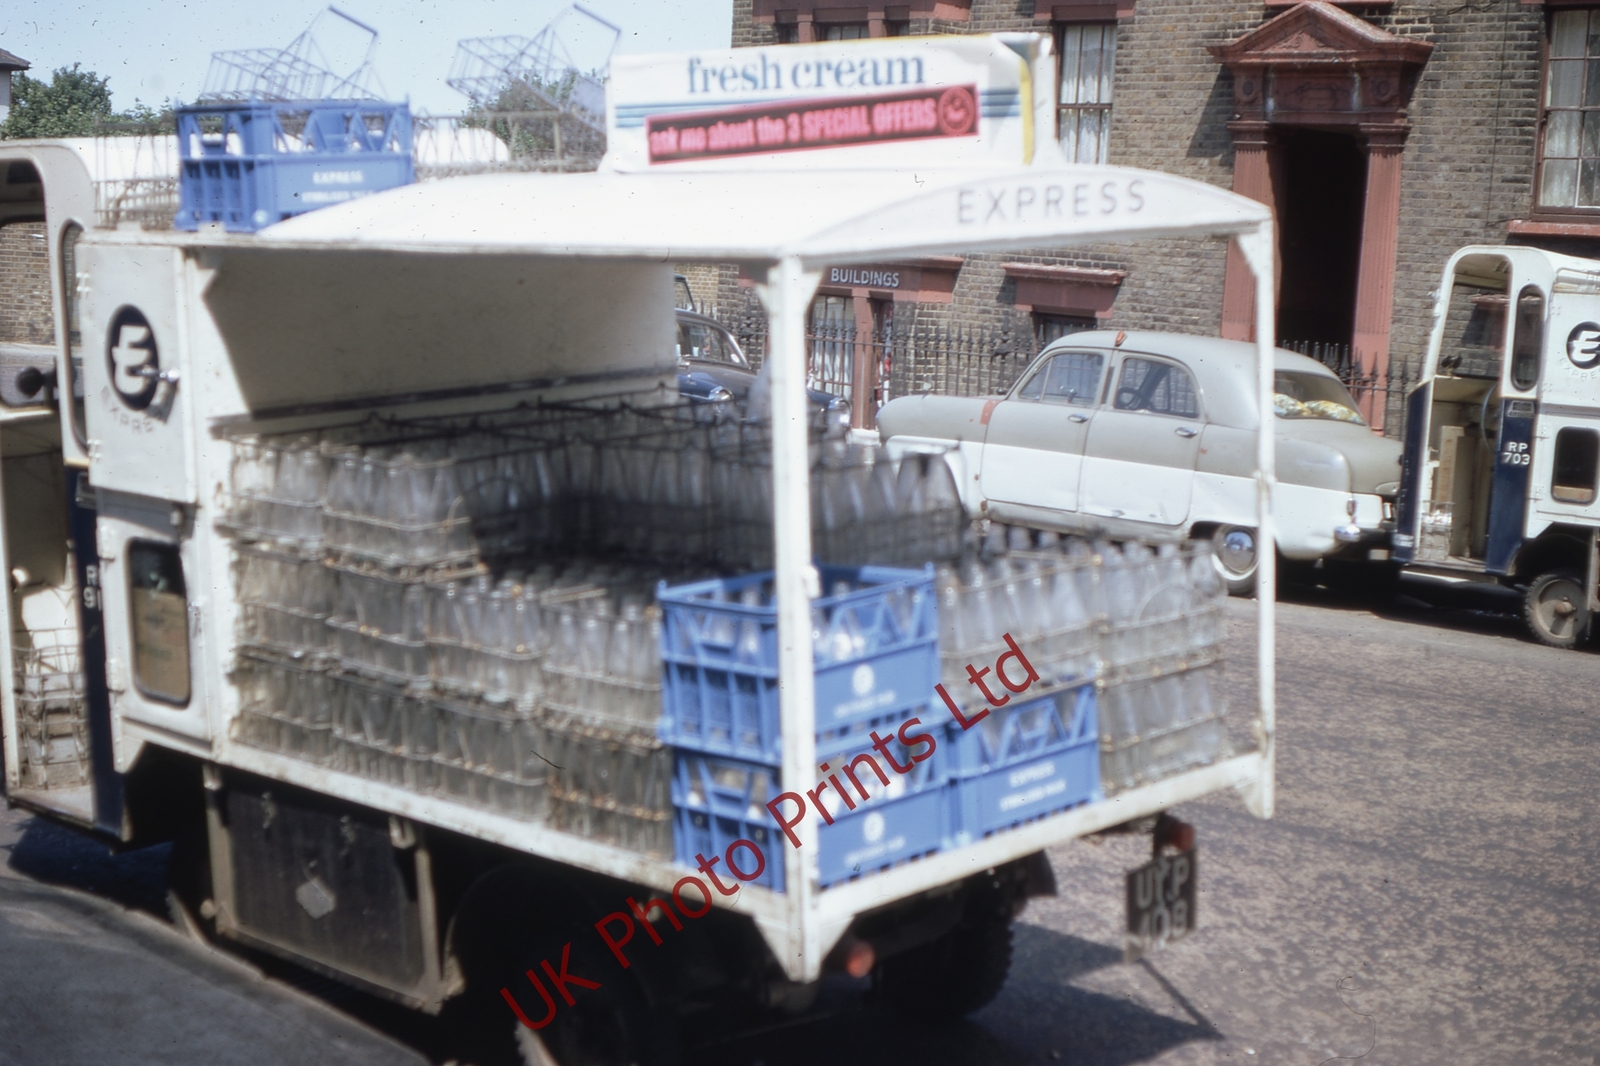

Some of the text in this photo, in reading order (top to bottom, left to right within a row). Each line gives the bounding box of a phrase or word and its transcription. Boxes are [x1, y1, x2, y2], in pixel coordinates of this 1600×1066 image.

[688, 53, 925, 93] fresh cream
[708, 119, 755, 149] about
[756, 115, 786, 145] the
[787, 112, 800, 143] 3
[802, 105, 870, 141] SPECIAL
[872, 97, 937, 135] OFFERS
[958, 179, 1146, 224] EXPRESS
[830, 267, 900, 288] BUILDINGS
[1503, 452, 1530, 466] 703
[1508, 441, 1528, 453] RP
